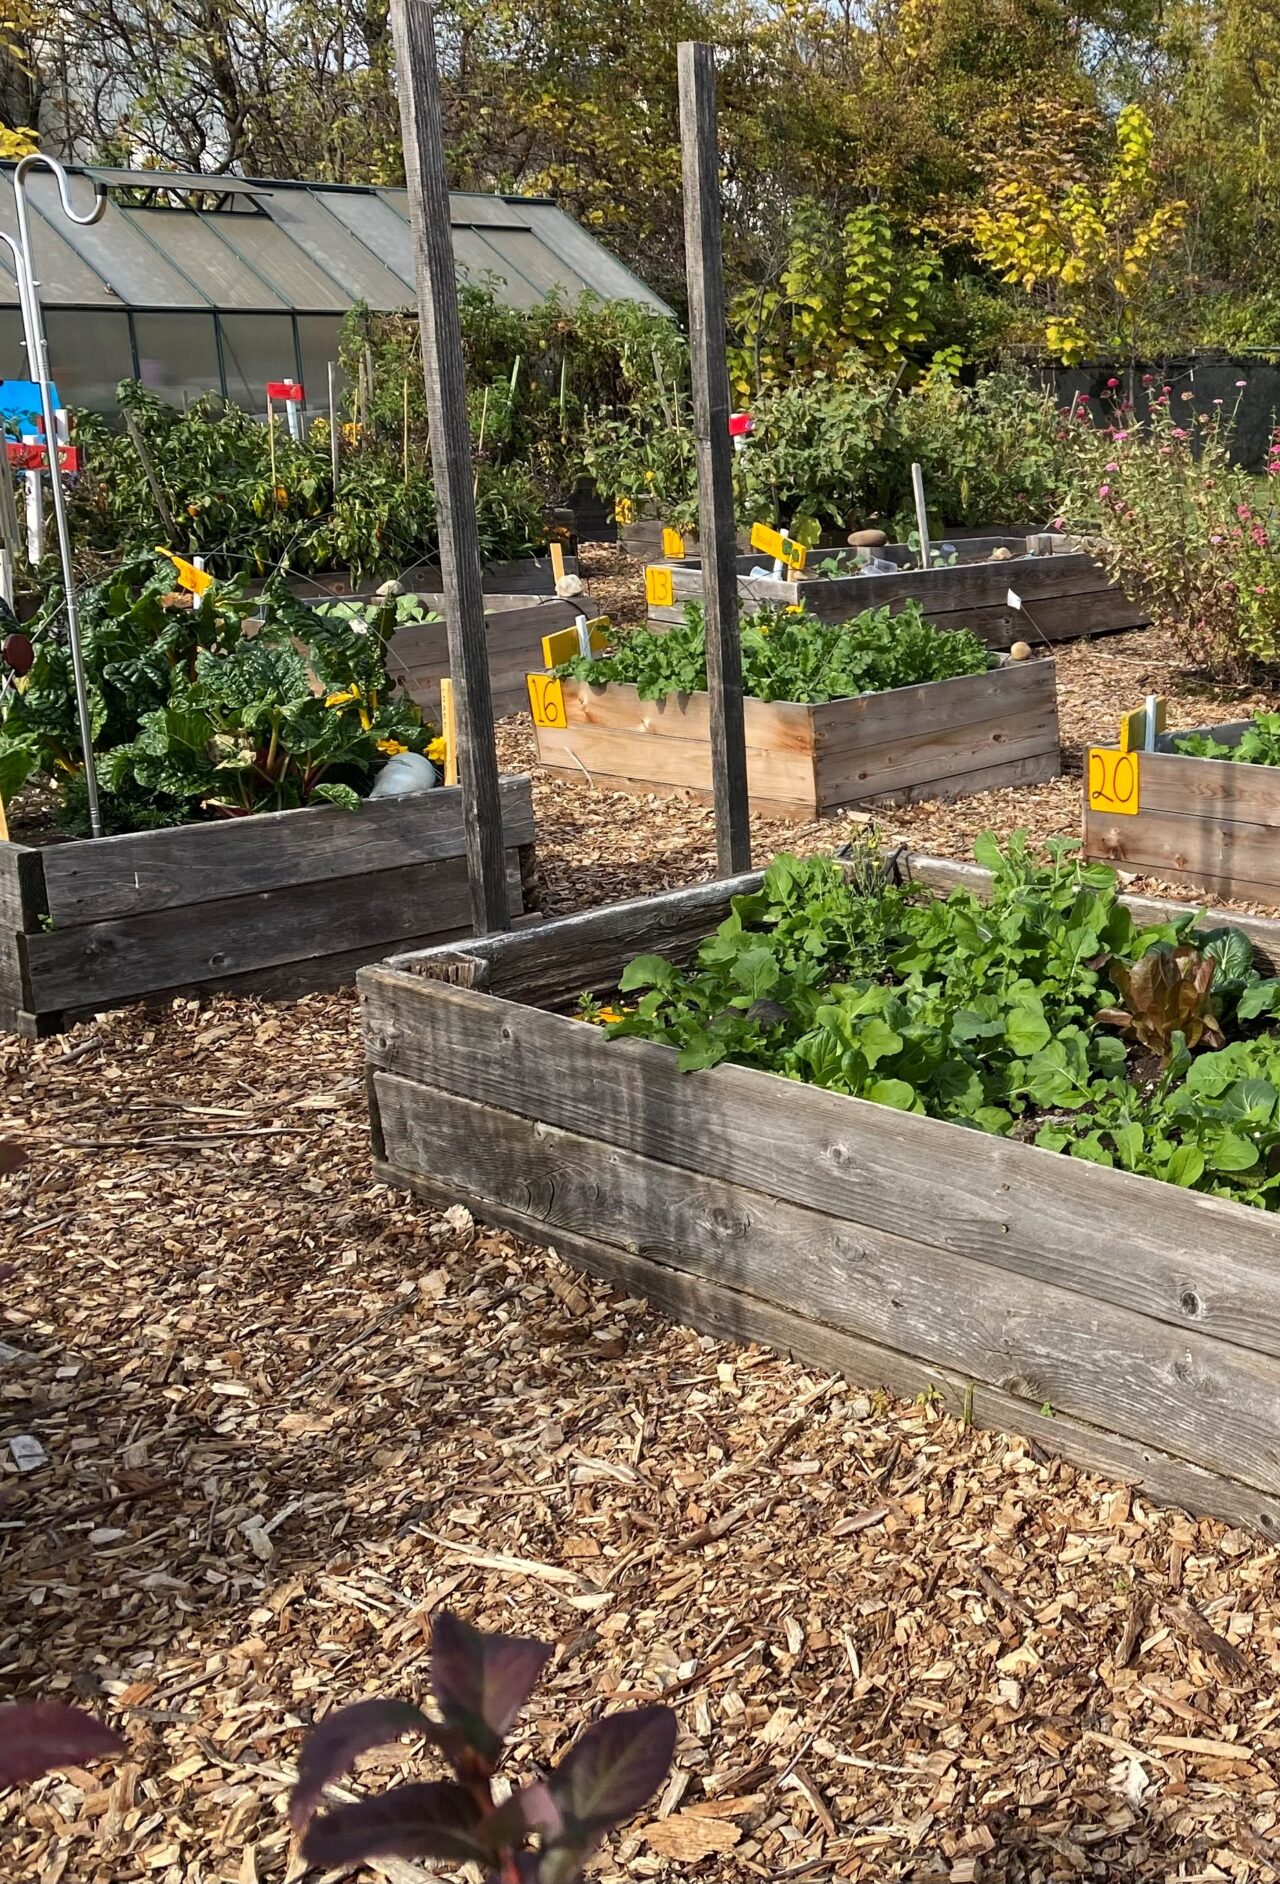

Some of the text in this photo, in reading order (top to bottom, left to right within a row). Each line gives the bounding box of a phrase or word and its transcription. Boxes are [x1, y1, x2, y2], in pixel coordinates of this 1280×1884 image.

[651, 570, 668, 601] 13
[531, 677, 558, 723] 16
[1091, 753, 1134, 802] 20
